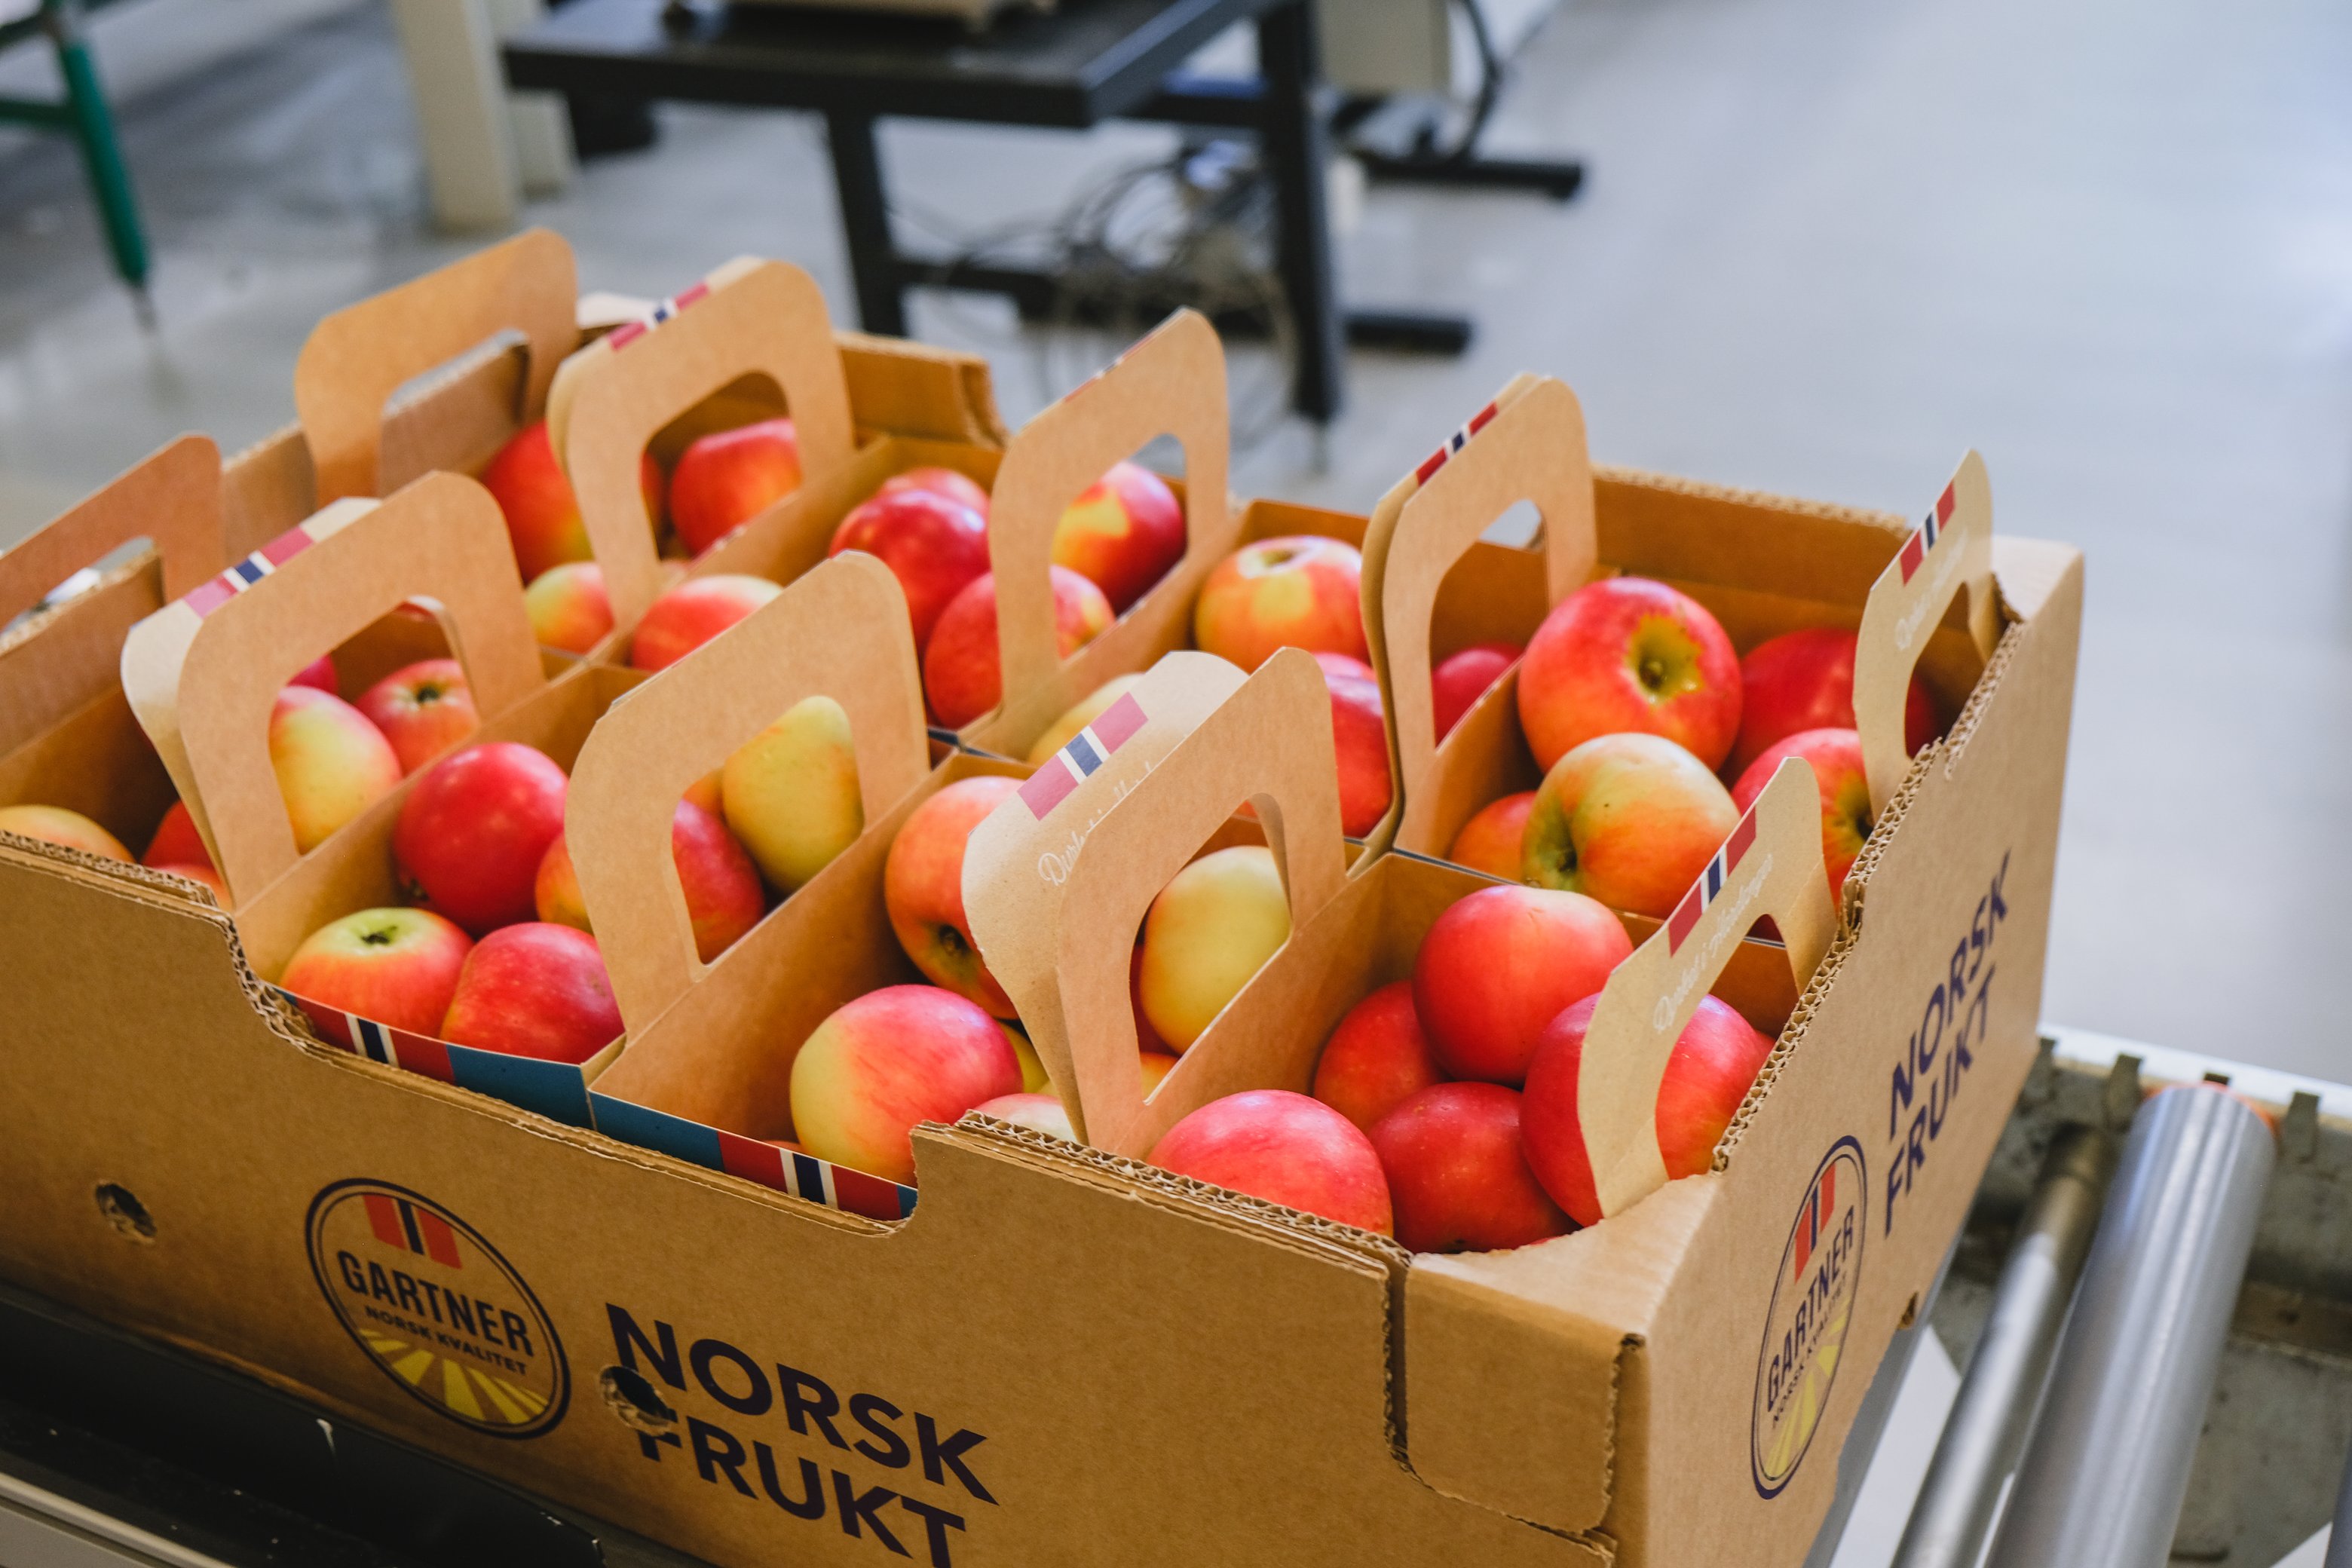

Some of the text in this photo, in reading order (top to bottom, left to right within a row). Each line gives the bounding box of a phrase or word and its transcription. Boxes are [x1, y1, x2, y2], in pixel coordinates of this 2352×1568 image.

[1889, 848, 2012, 1141] NORSK
[1885, 962, 1995, 1239] FRUKT
[337, 1251, 534, 1357] GARTNER
[365, 1305, 528, 1376] NORSK KVALITET
[605, 1303, 1000, 1506] NORSK
[1768, 1205, 1854, 1413] GARTNER
